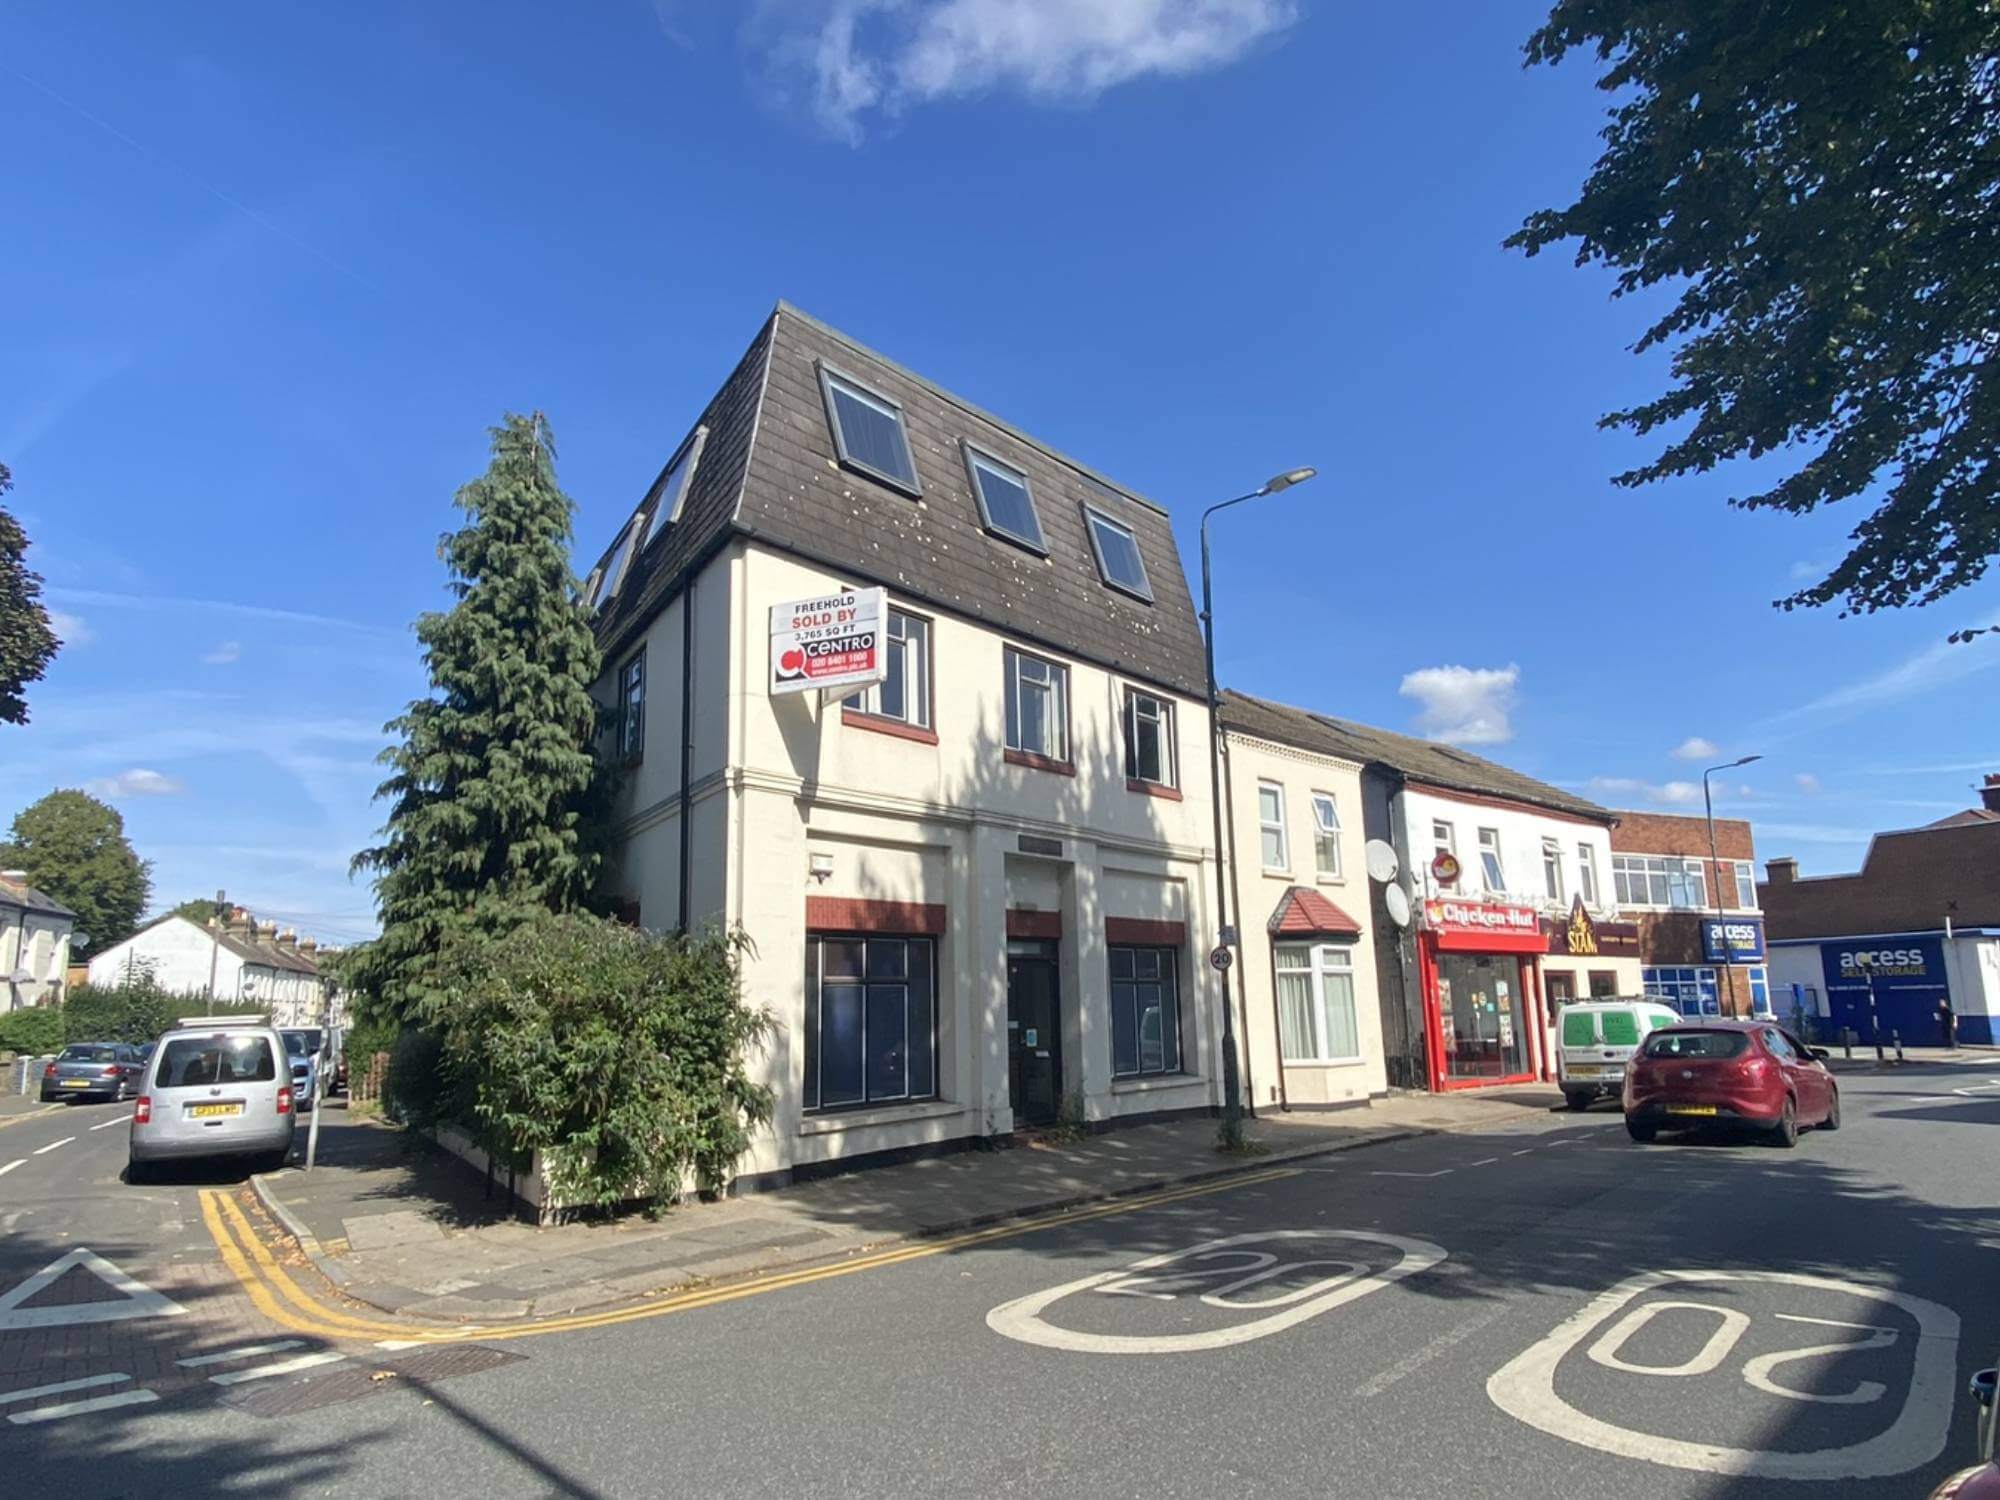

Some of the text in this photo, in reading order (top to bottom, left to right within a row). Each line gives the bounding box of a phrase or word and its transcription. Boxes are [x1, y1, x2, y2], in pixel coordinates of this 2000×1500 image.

[795, 596, 855, 614] FREEHOLD
[792, 608, 857, 629] SOLD BY
[825, 627, 840, 637] SQ
[843, 624, 856, 634] FT
[1443, 904, 1534, 928] Chicken Hut
[1213, 951, 1229, 964] 20
[1872, 965, 1927, 977] STORAGE
[1094, 1251, 1370, 1309] 20
